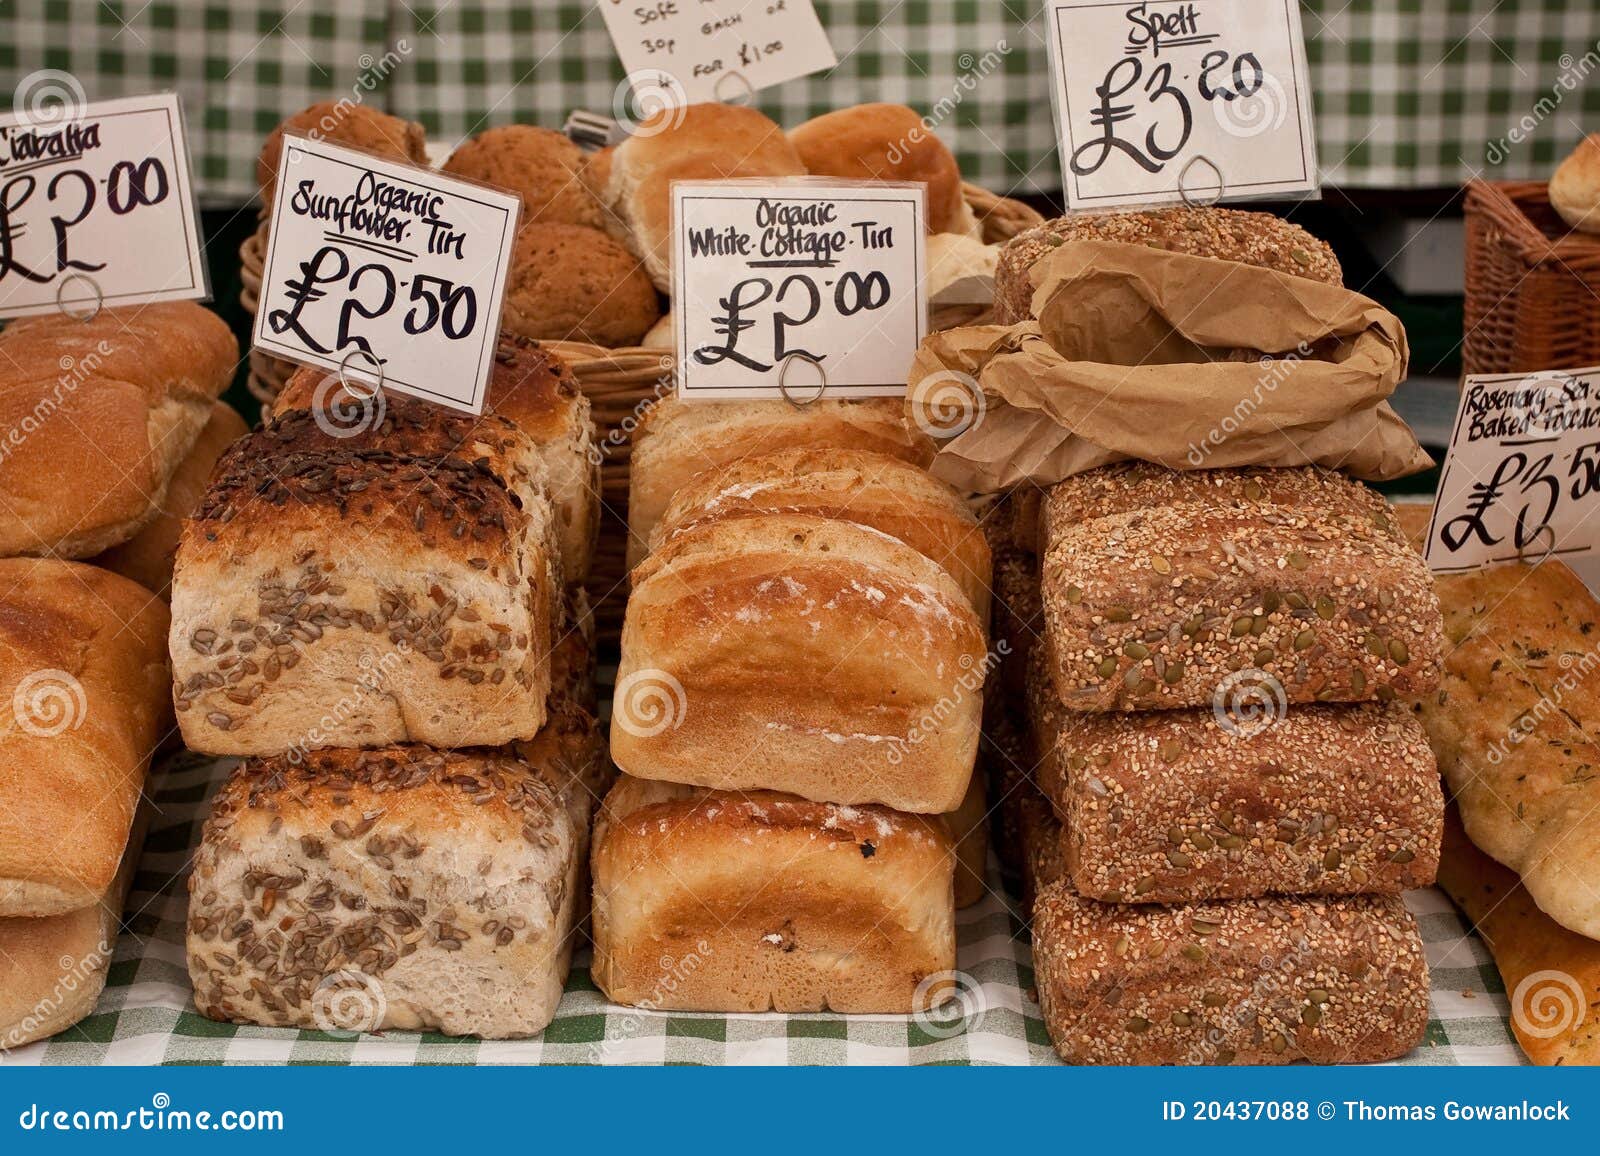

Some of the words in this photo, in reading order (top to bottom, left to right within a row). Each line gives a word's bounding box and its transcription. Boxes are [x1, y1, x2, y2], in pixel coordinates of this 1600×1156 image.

[1126, 2, 1200, 57] Spelt
[693, 60, 723, 77] FOR
[1070, 50, 1263, 176] £3.20
[355, 170, 444, 219] Organic
[756, 198, 837, 232] Organic
[422, 218, 466, 259] Tin
[852, 221, 893, 249] Tin
[268, 246, 477, 365] £2.50
[693, 271, 891, 373] £2.00
